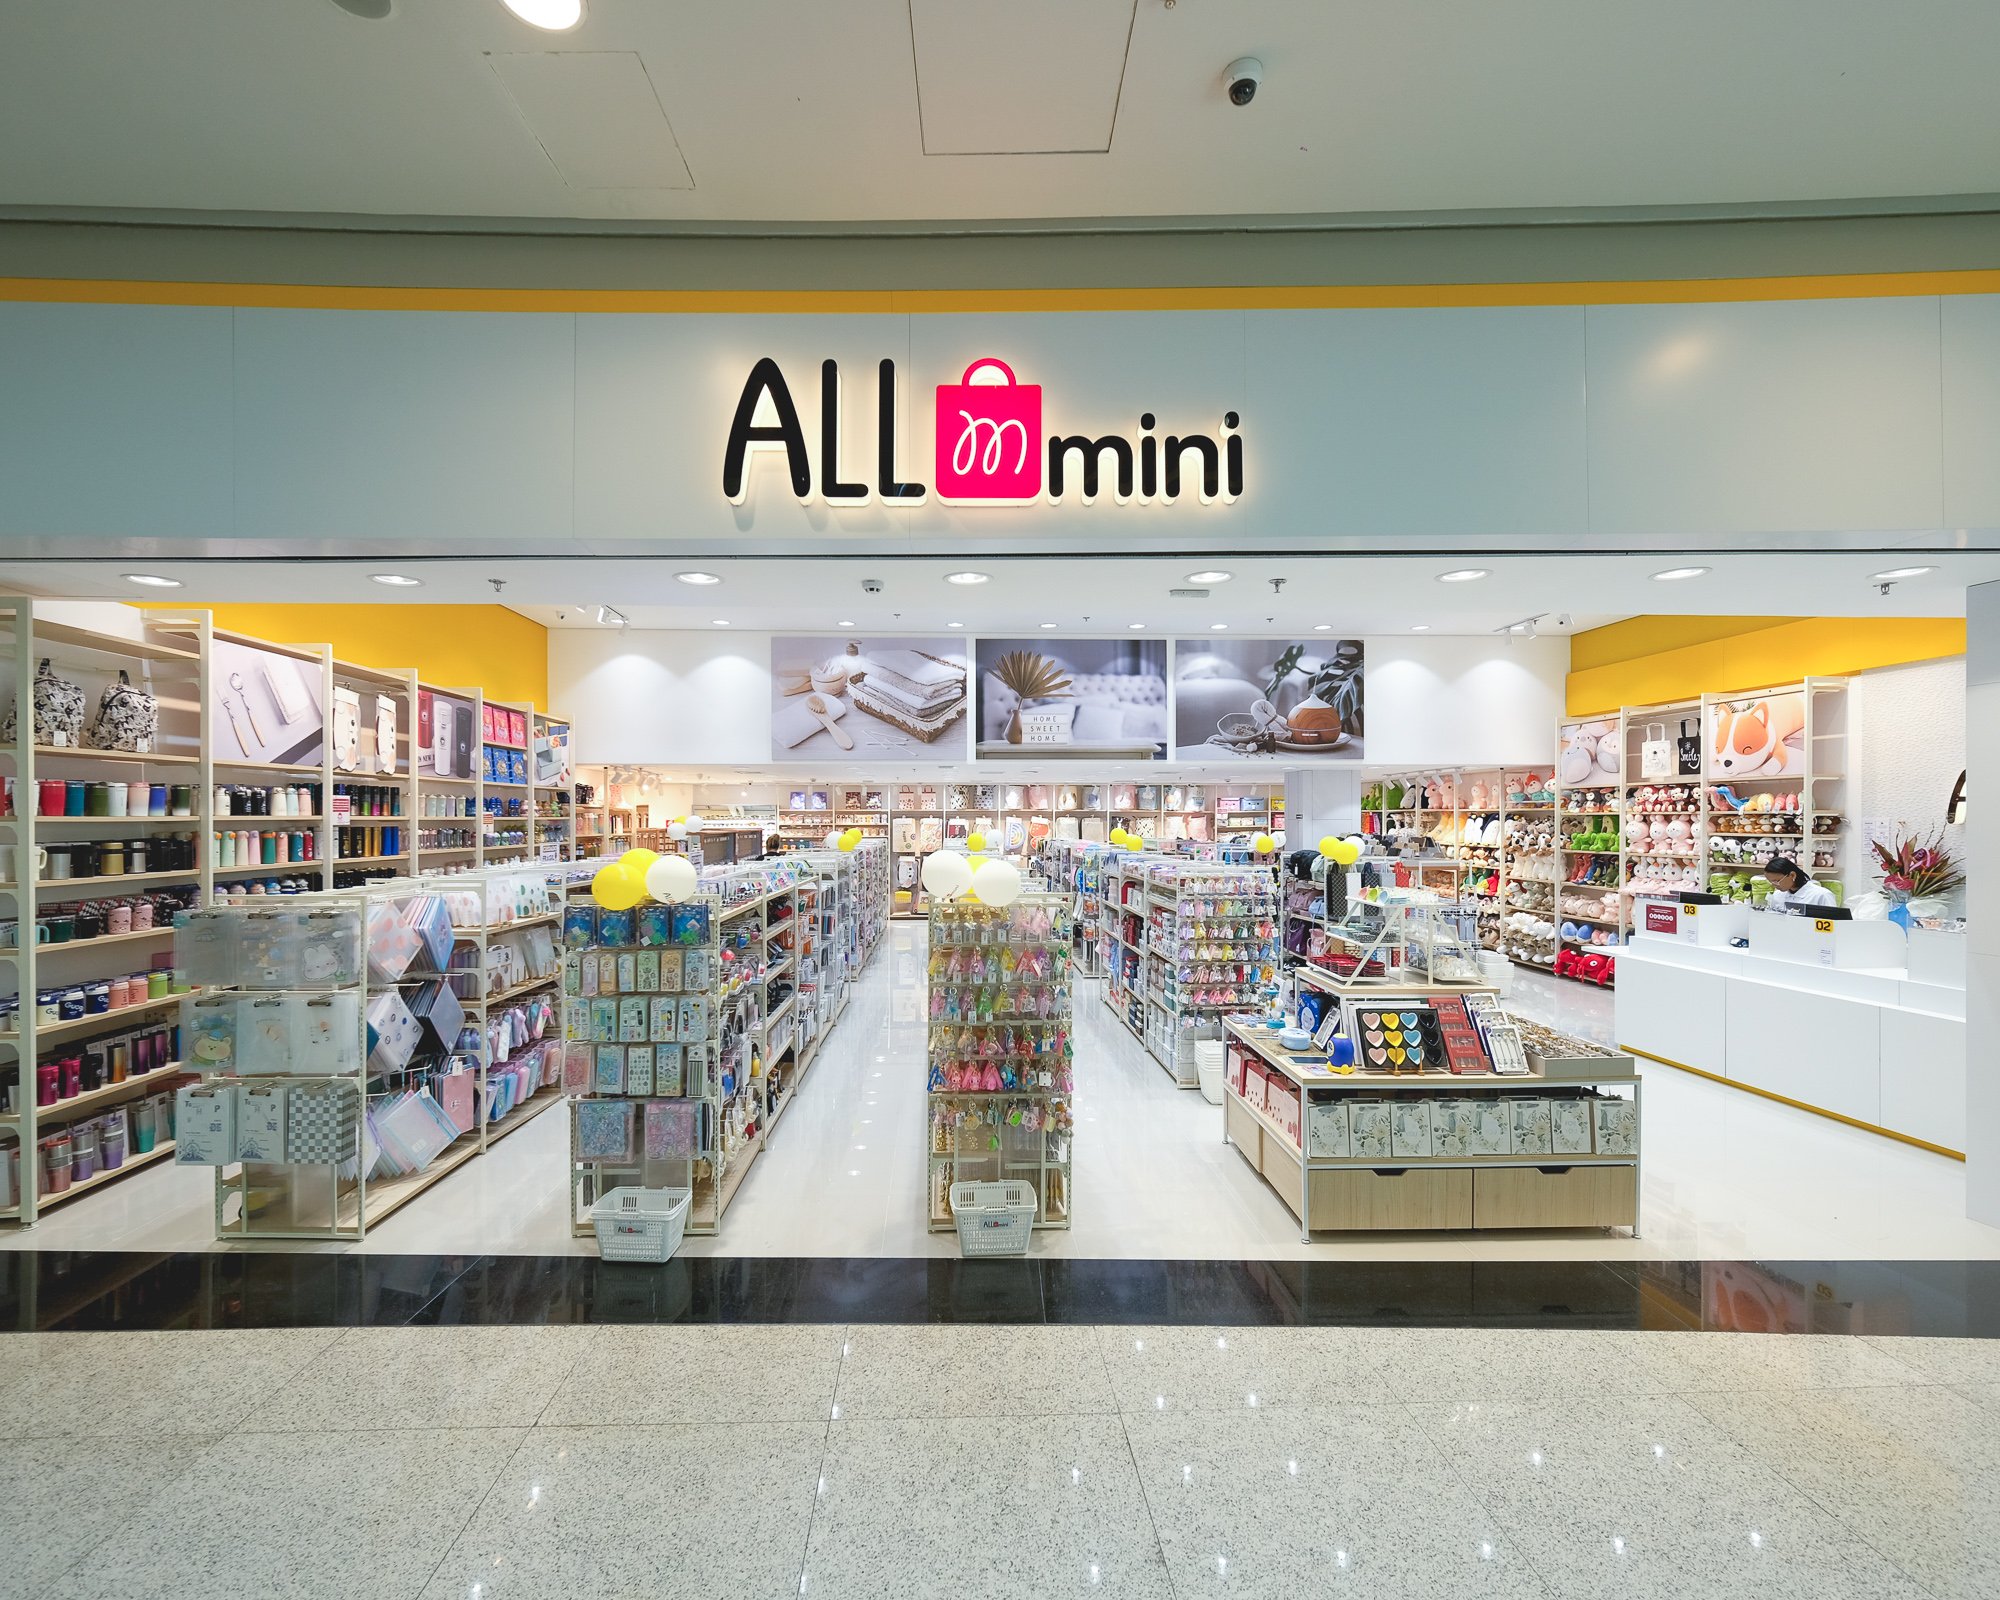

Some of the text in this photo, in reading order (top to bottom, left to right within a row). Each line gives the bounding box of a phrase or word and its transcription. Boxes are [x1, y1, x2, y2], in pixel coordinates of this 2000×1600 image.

[723, 357, 927, 498] ALL
[1047, 411, 1243, 498] mini
[1033, 715, 1057, 723] HOME
[1684, 905, 1696, 915] 03
[1816, 920, 1831, 932] 02
